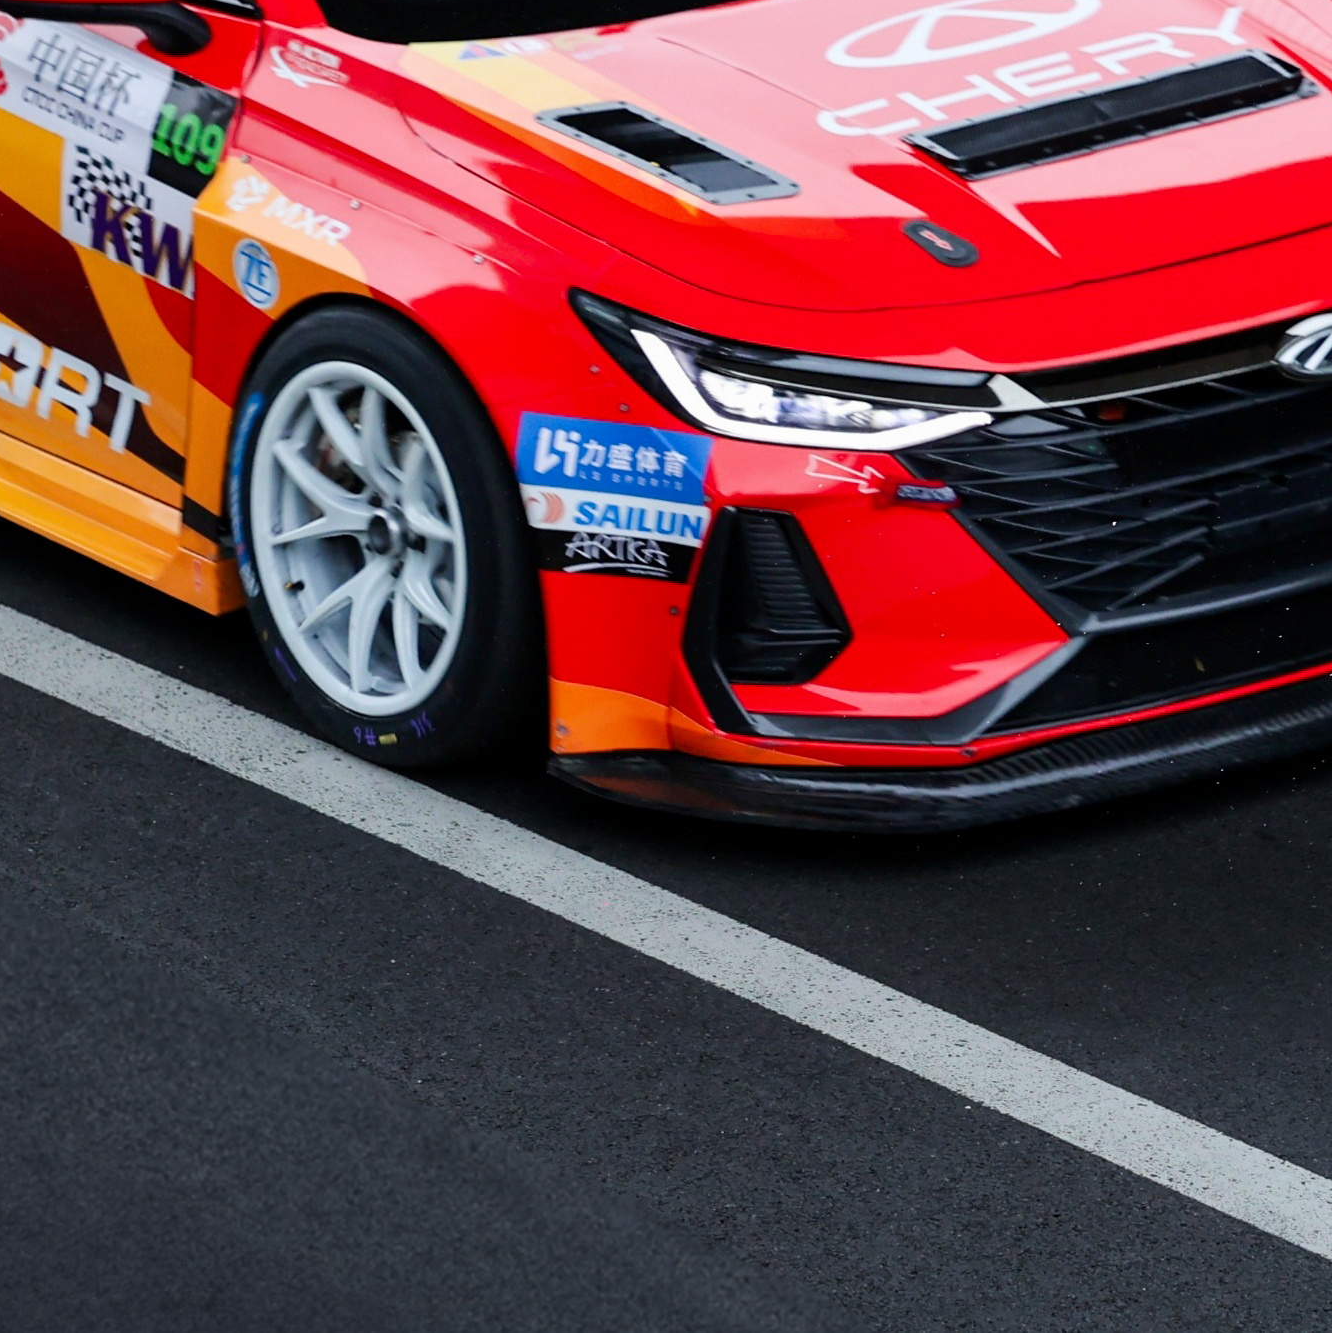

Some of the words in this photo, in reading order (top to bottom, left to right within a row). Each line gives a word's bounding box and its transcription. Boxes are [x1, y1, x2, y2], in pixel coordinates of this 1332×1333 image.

[27, 33, 144, 118] 中国杯
[817, 8, 1248, 138] CHERY
[23, 87, 57, 114] CTCC
[58, 101, 95, 131] CHINA
[97, 122, 124, 144] CUP
[150, 103, 226, 175] 109
[90, 187, 194, 297] KW
[262, 196, 351, 246] MXR
[579, 439, 688, 478] 力盛体育
[574, 501, 702, 540] SAILUN
